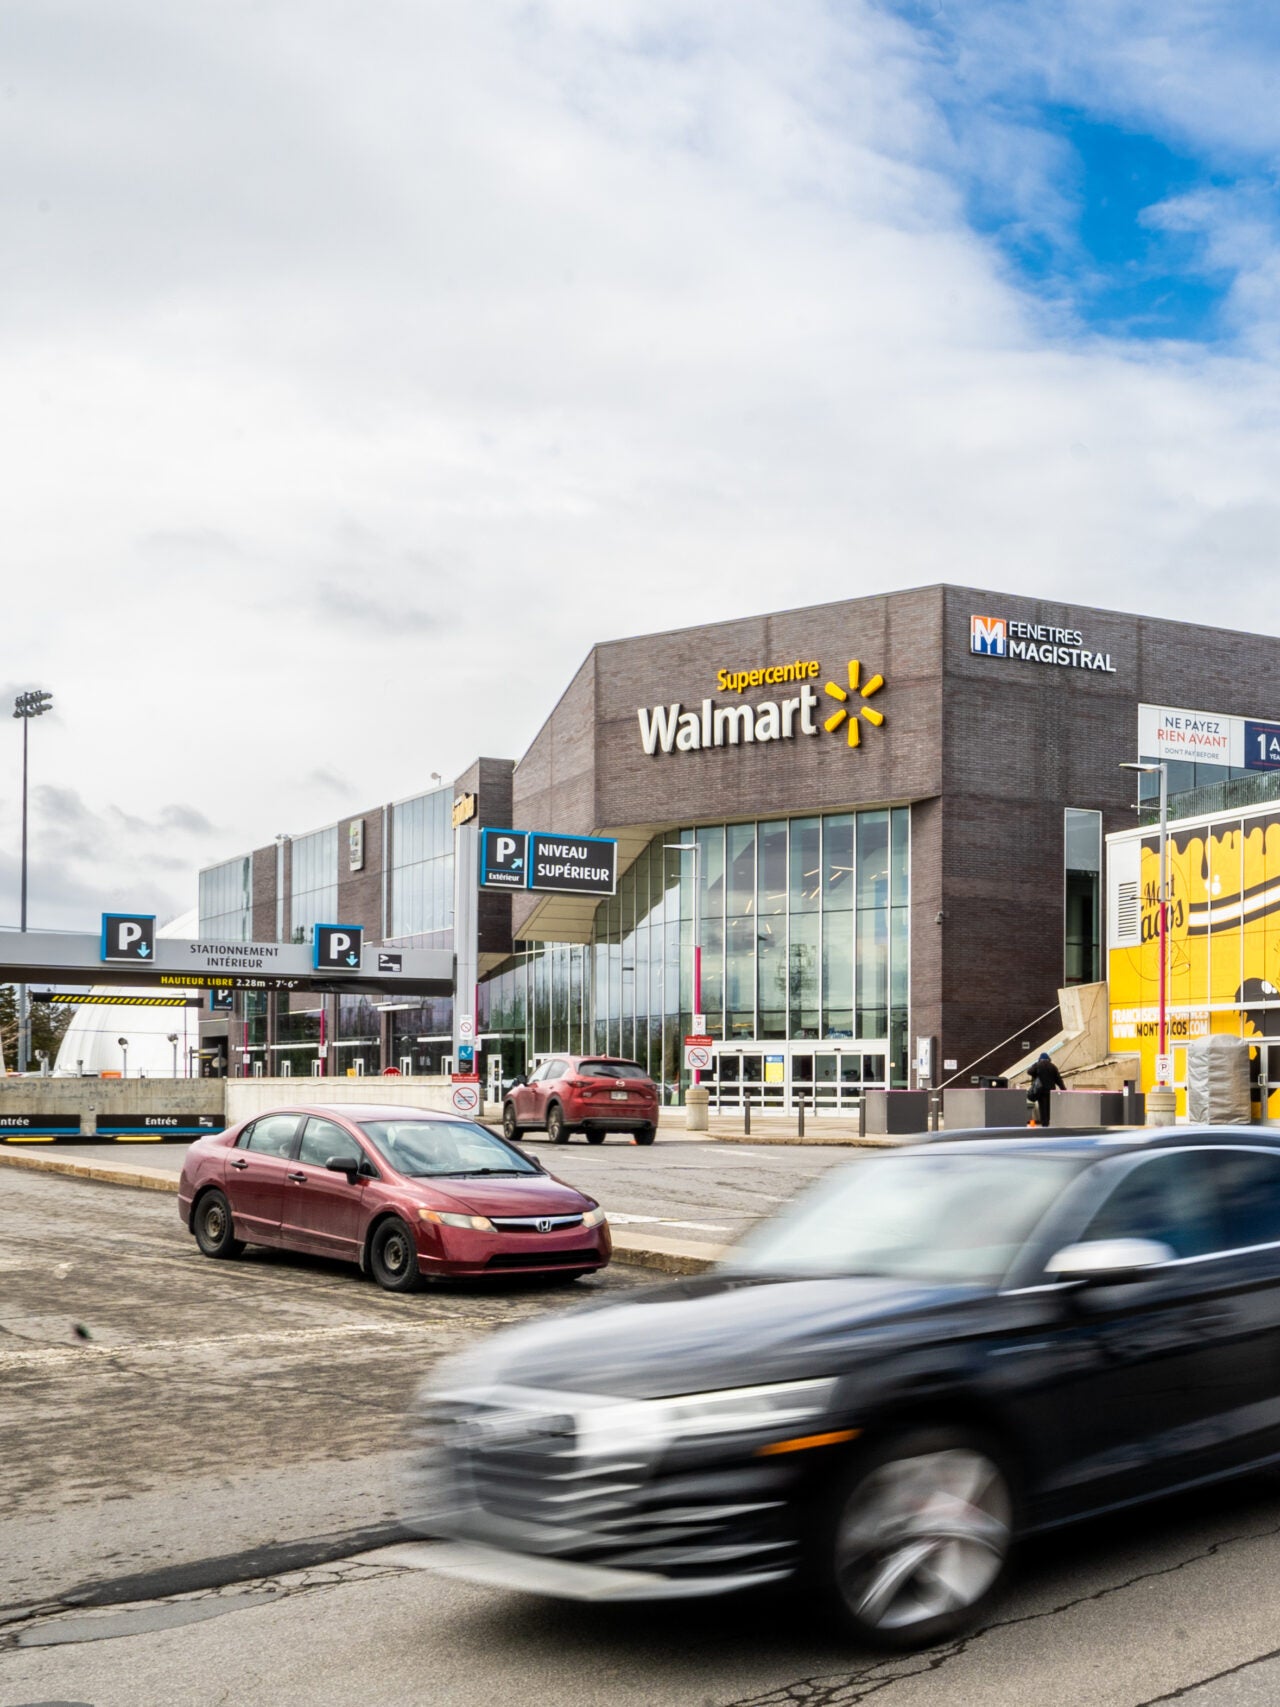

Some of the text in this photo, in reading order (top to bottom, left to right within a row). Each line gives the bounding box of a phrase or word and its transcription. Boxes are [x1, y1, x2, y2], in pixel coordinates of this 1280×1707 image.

[1008, 621, 1083, 646] FENETRES
[1008, 640, 1117, 673] MAGISTRAL
[716, 660, 820, 694] Supercentre
[637, 684, 819, 755] Walmart
[1165, 716, 1220, 734] NE PAYEZ
[1157, 728, 1228, 748] RIEN AVANT
[1257, 733, 1266, 761] 1
[1165, 747, 1220, 760] DON'T PAY BEFORE
[496, 837, 516, 863] P
[538, 843, 588, 860] NIVEAU
[488, 872, 520, 882] Extérieur
[537, 862, 610, 882] SUPÉRIEUR
[1141, 899, 1184, 943] acos
[118, 922, 142, 951] P
[329, 932, 351, 960] P
[190, 944, 279, 957] STATIONNEMENT
[207, 957, 263, 969] INTÉRIEUR
[160, 976, 204, 986] HAUTEUR
[207, 978, 234, 987] LIBRE
[236, 979, 266, 988] 2.28m
[0, 1116, 30, 1126] ntrée
[145, 1116, 178, 1126] Entrée
